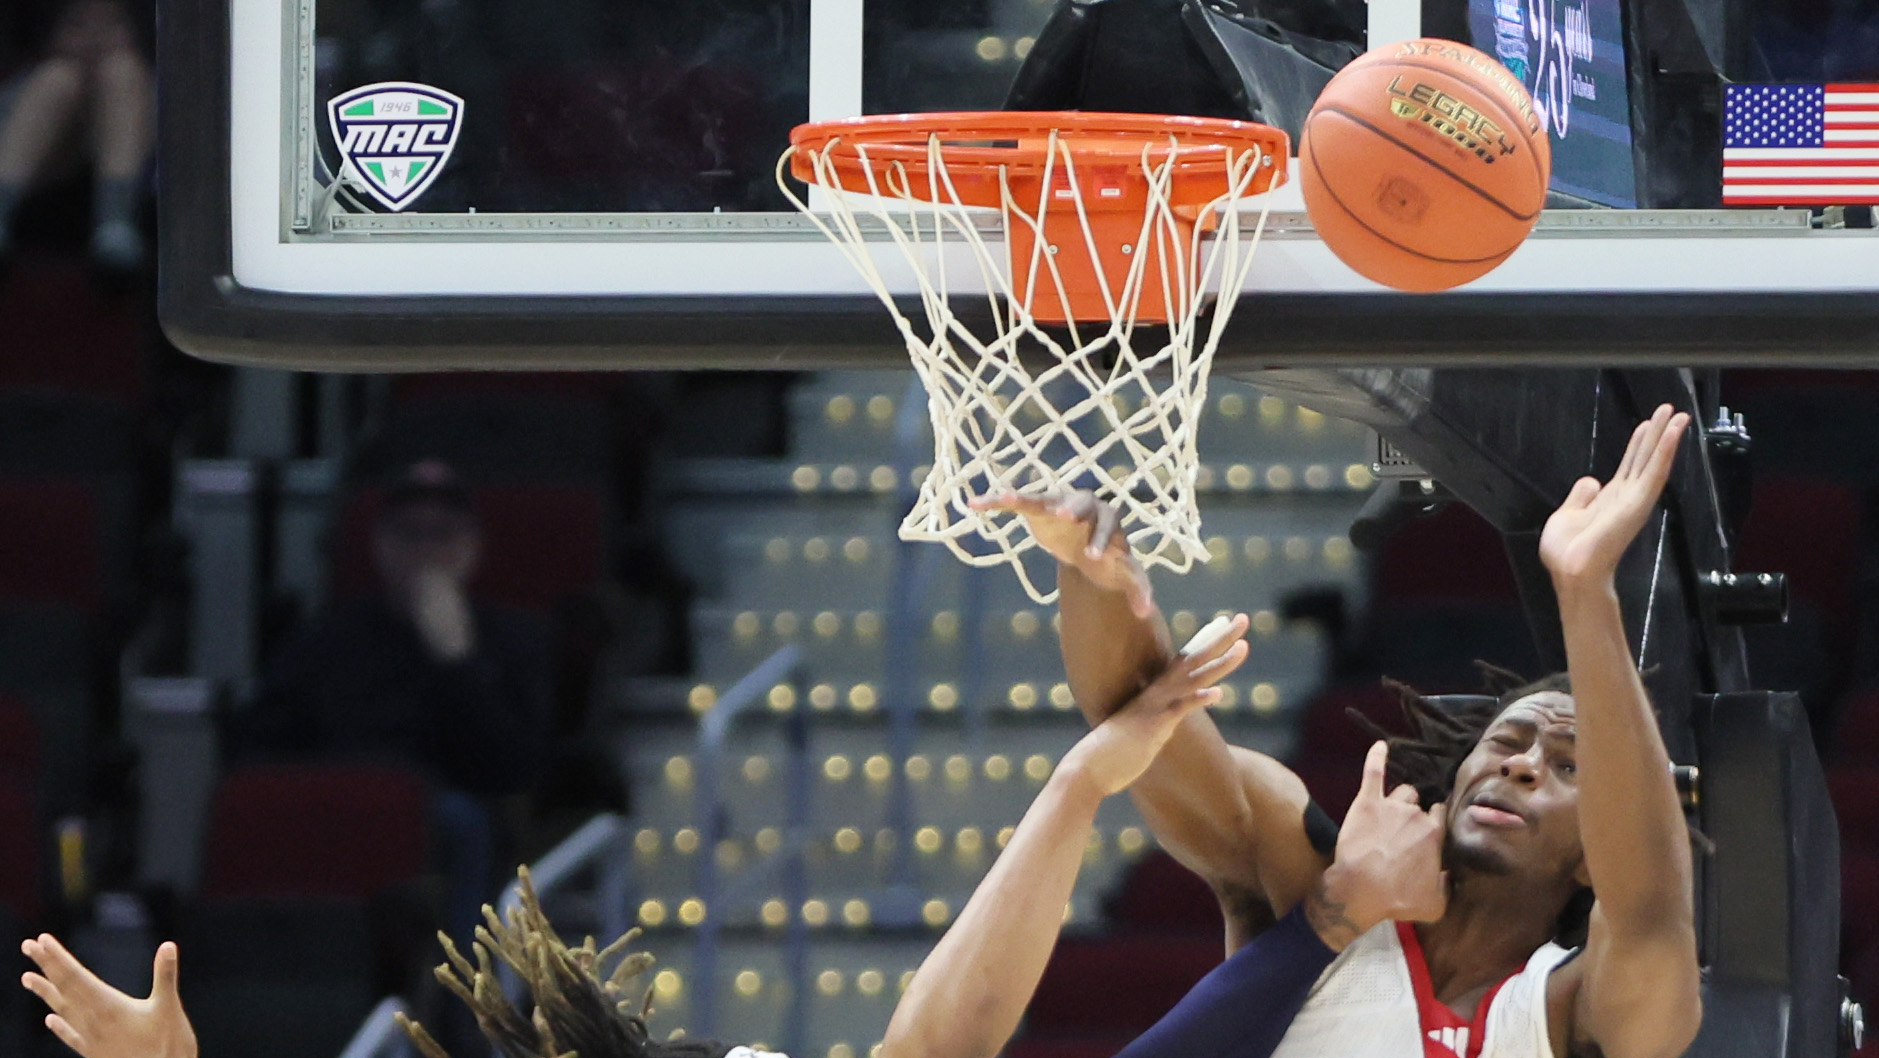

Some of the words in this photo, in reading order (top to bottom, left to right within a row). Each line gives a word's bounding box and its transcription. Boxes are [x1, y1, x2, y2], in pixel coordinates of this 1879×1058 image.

[380, 102, 412, 112] 1946
[1386, 75, 1516, 156] LEGACY
[342, 124, 449, 153] MAC
